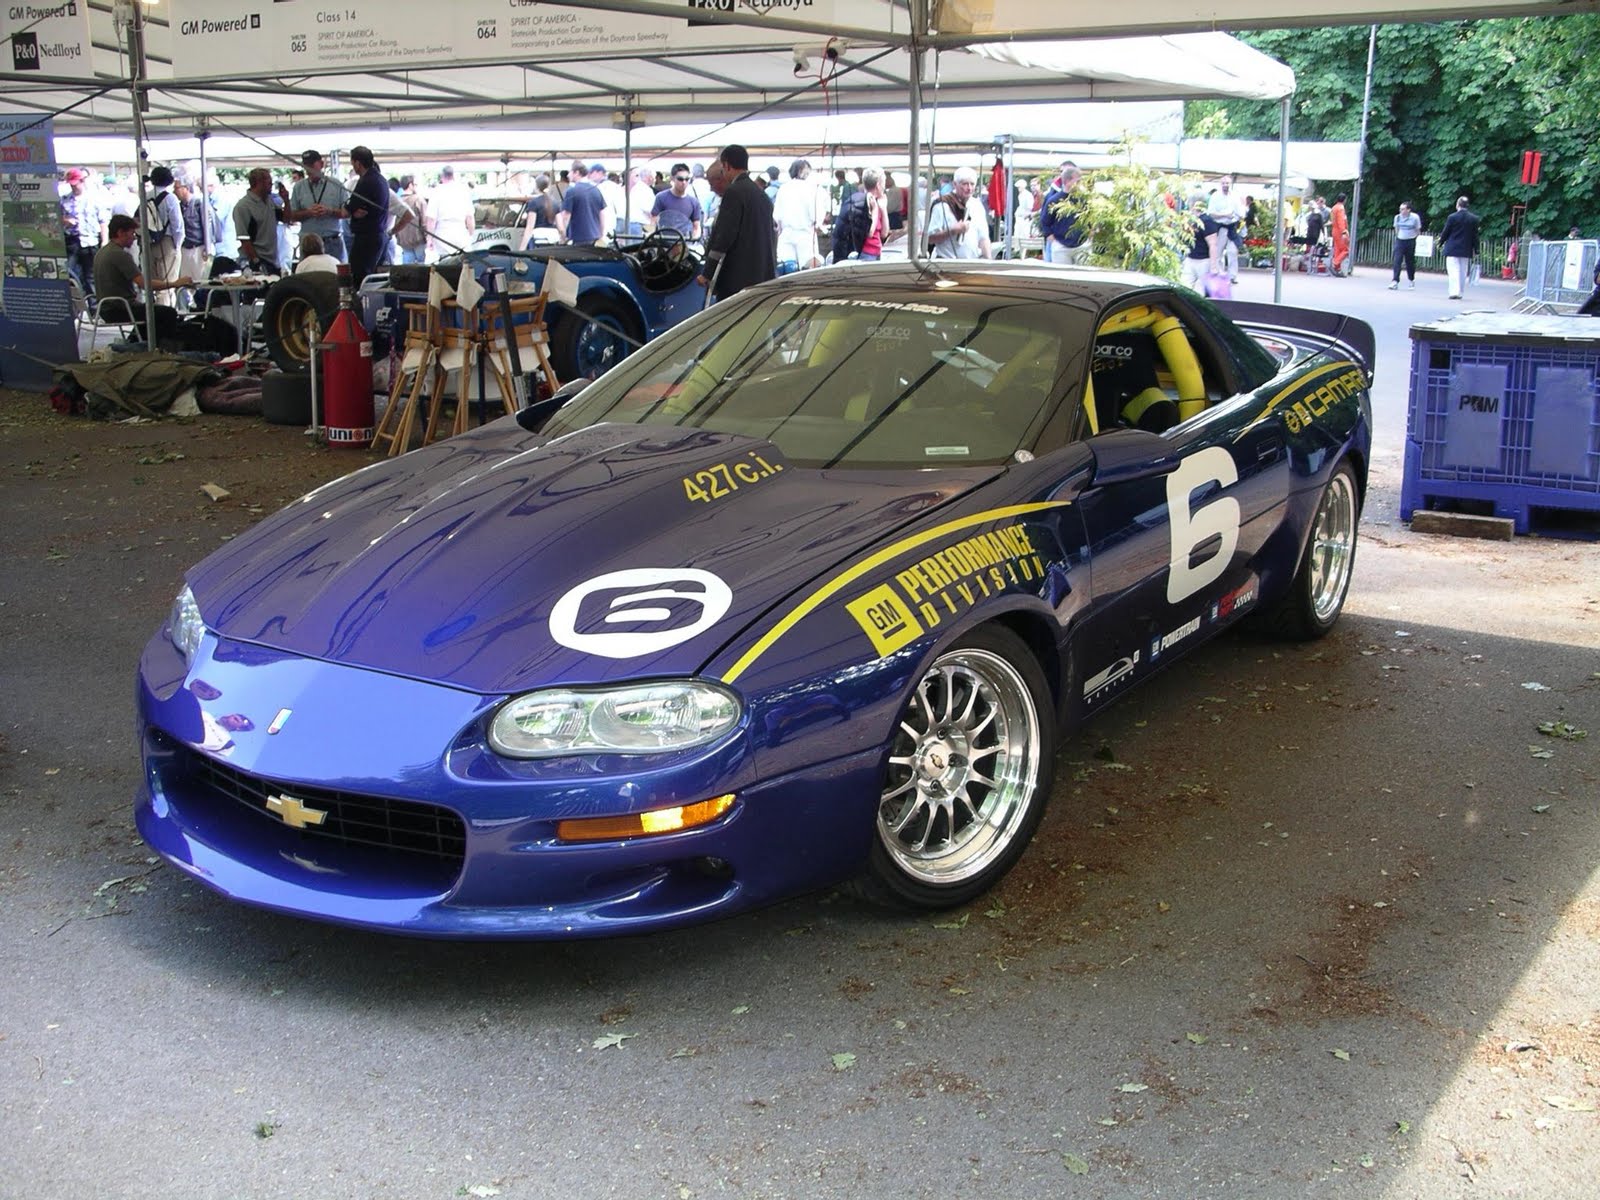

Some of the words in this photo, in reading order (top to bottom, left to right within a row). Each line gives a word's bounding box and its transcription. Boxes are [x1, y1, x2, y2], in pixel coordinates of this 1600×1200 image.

[9, 6, 24, 20] GM
[26, 4, 65, 19] Powered
[316, 12, 341, 23] Class
[345, 9, 356, 20] 14
[181, 20, 199, 35] GM
[202, 14, 248, 33] Powered
[511, 17, 531, 26] SPIRIT
[532, 16, 543, 25] OF
[544, 14, 577, 24] AMERICA
[346, 29, 375, 38] AMERICA
[477, 27, 497, 39] 064
[538, 28, 570, 36] Production
[15, 44, 36, 59] P&O
[40, 43, 81, 59] Nedlloyd
[291, 40, 307, 52] 065
[477, 230, 512, 242] Alitalia
[1166, 446, 1241, 604] 6
[895, 523, 1036, 604] PERFORMANCE
[919, 556, 1045, 628] DIVISION
[866, 599, 903, 631] GM
